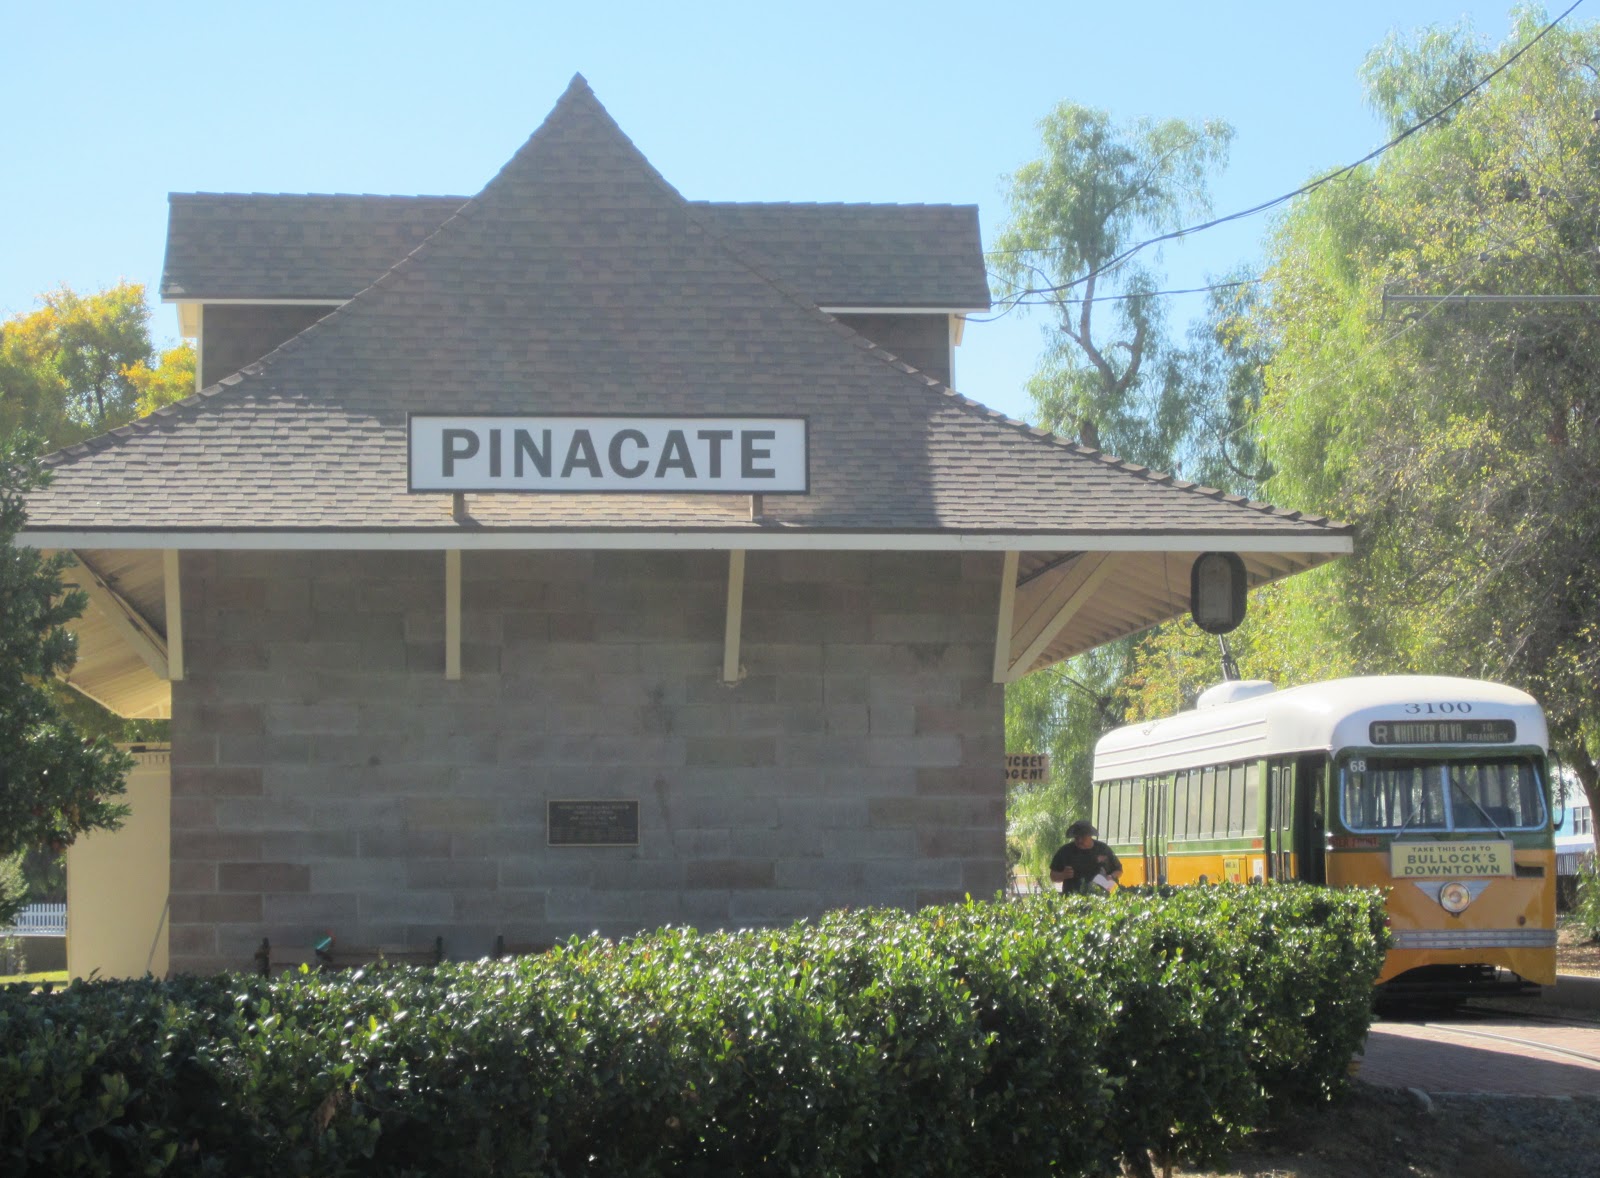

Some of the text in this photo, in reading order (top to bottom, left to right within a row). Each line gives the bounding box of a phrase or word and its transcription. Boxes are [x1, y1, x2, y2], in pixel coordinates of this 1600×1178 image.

[441, 428, 776, 479] PINACATE
[1405, 702, 1472, 714] 3100
[1374, 725, 1388, 742] R
[1005, 755, 1045, 767] ICKET
[1350, 760, 1366, 772] 68
[1407, 853, 1497, 864] BULLOCK'S
[1404, 865, 1500, 875] DOWNTOWN
